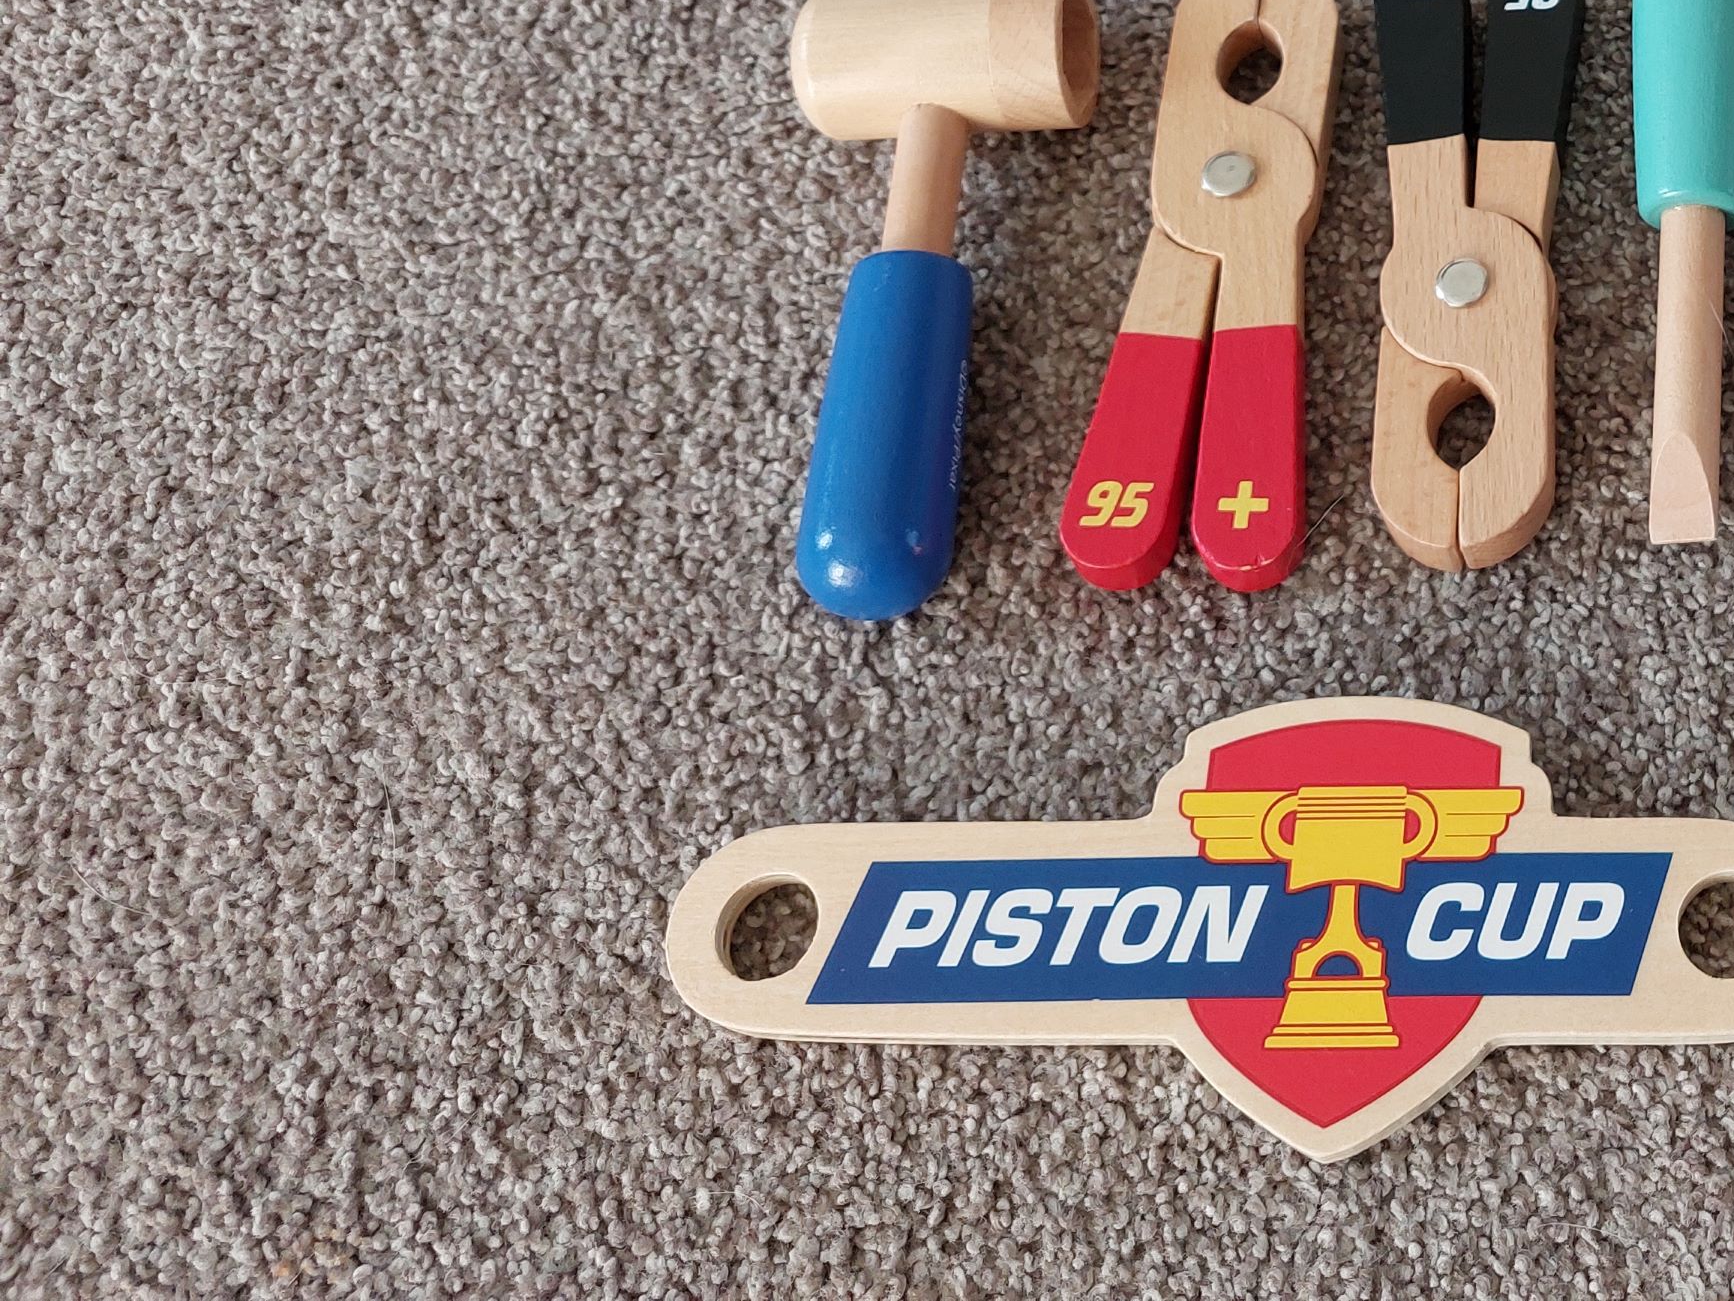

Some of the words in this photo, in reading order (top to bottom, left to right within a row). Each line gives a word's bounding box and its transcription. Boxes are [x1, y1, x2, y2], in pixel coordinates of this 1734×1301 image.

[1079, 480, 1155, 528] 95
[868, 883, 1270, 969] PISTON
[1406, 880, 1624, 961] CUP
